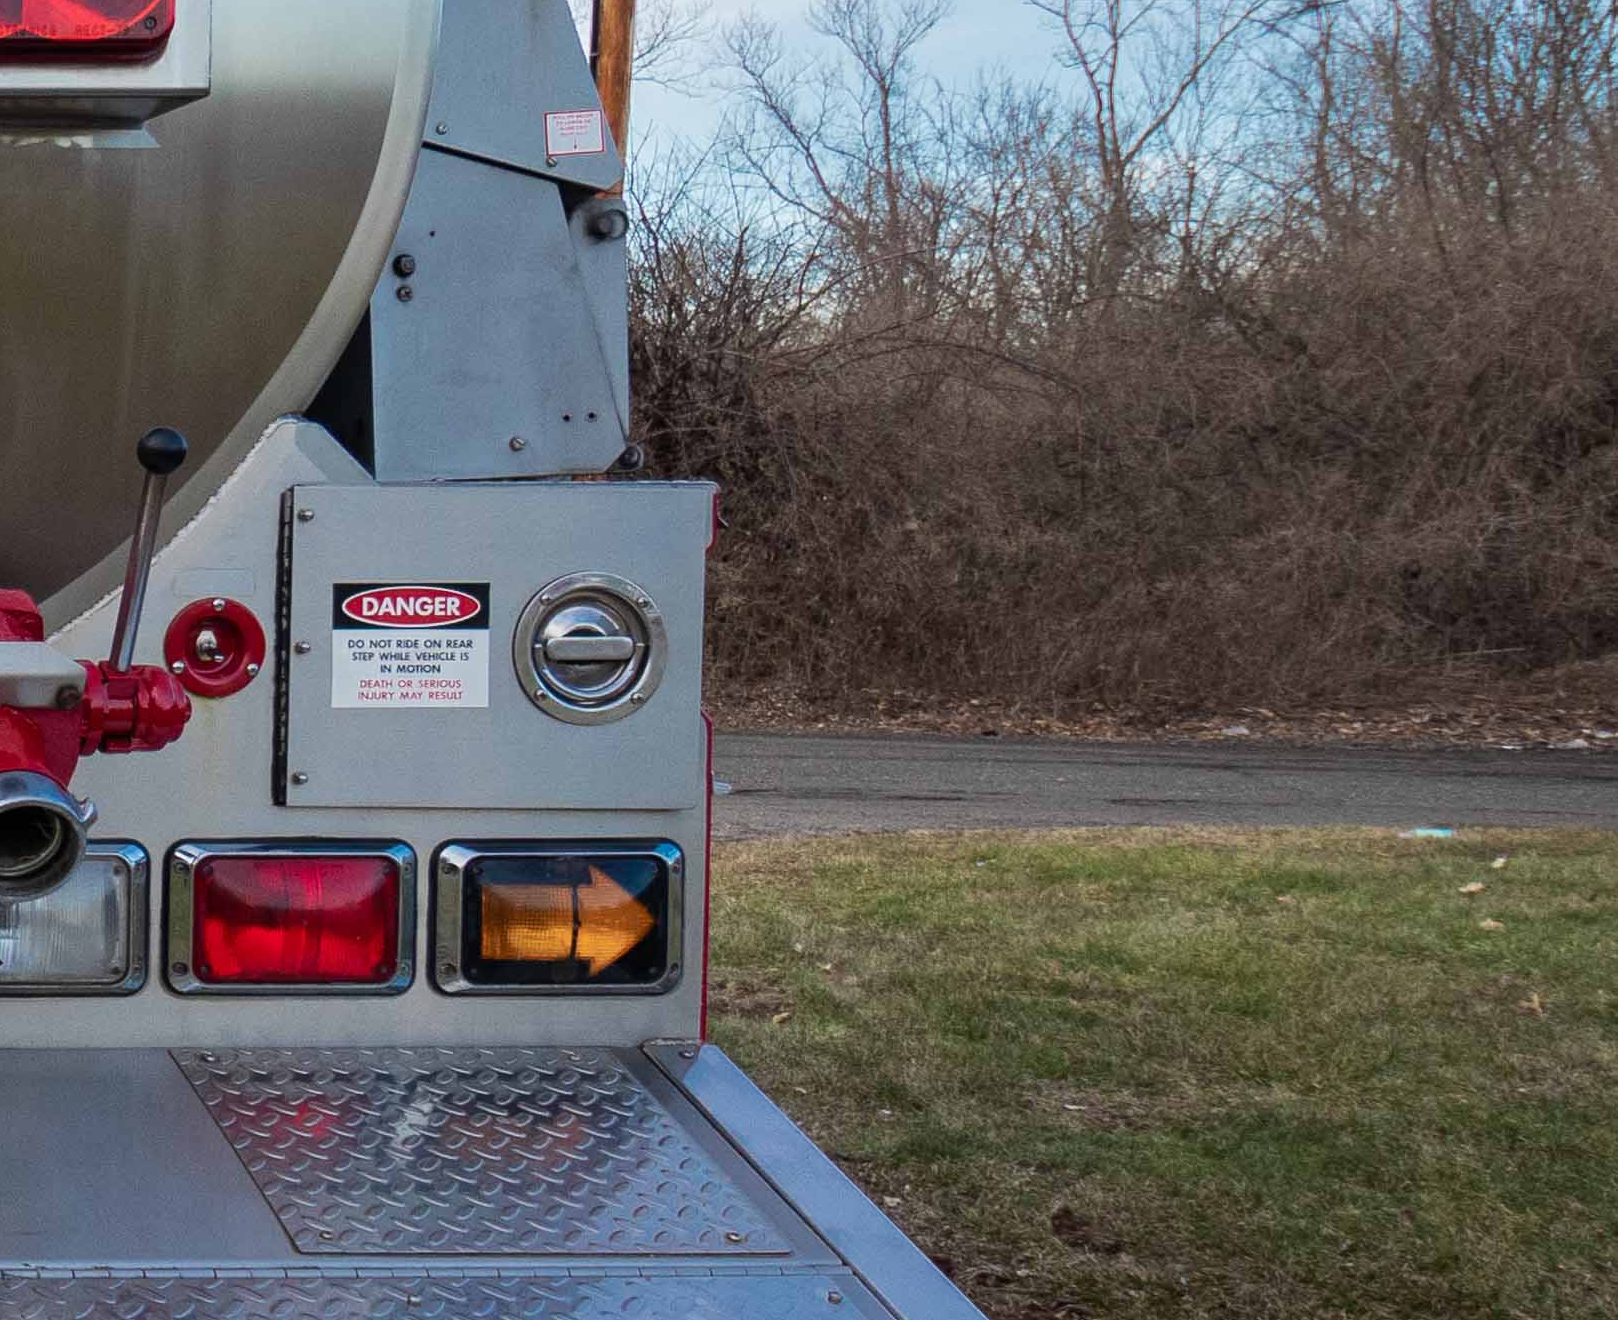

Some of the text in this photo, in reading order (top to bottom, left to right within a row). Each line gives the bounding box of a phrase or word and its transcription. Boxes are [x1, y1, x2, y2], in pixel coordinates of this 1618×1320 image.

[362, 596, 461, 616] DANGER
[348, 640, 473, 649] DO NOT RIDE ON REAR
[352, 652, 469, 661] STEP WHILE VEHICLE IS
[380, 665, 441, 673] IN MOTION
[360, 679, 461, 688] DEATH OR SERIOUS
[358, 692, 395, 700] INJURY
